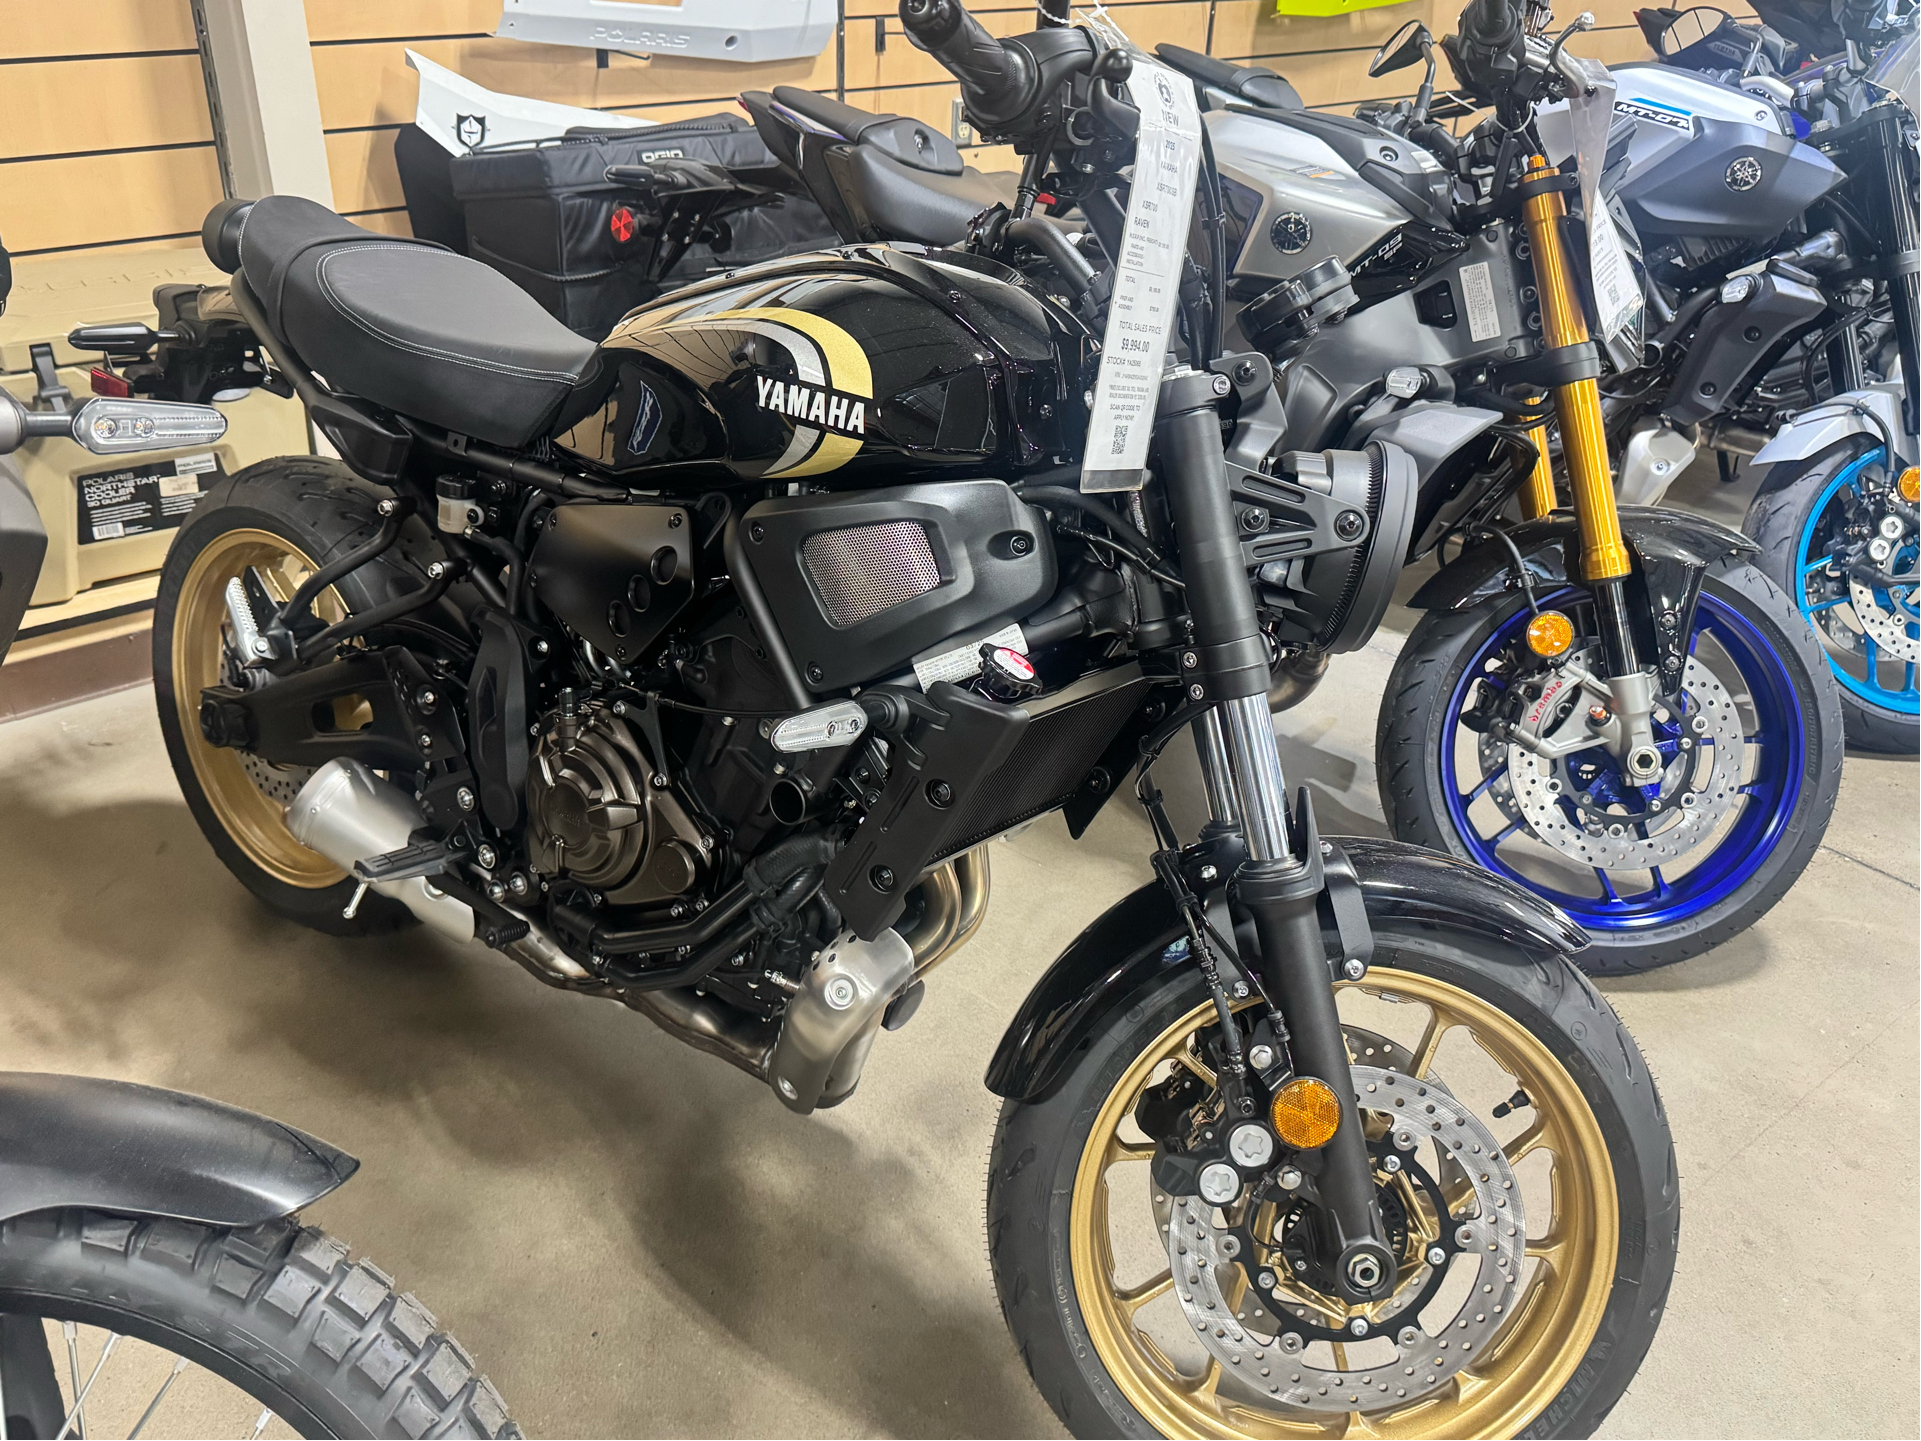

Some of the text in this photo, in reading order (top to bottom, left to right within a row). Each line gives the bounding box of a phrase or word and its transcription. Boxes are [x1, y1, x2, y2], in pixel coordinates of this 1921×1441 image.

[1134, 217, 1150, 229] RAVEN
[1119, 320, 1162, 335] TOTAL SALES PRICE
[1121, 337, 1150, 353] $9,994.00
[1107, 356, 1126, 365] STOCK#
[756, 375, 865, 435] YAMAHA
[85, 486, 136, 502] COOLER
[101, 494, 132, 506] QUART
[1528, 681, 1562, 723] brembo
